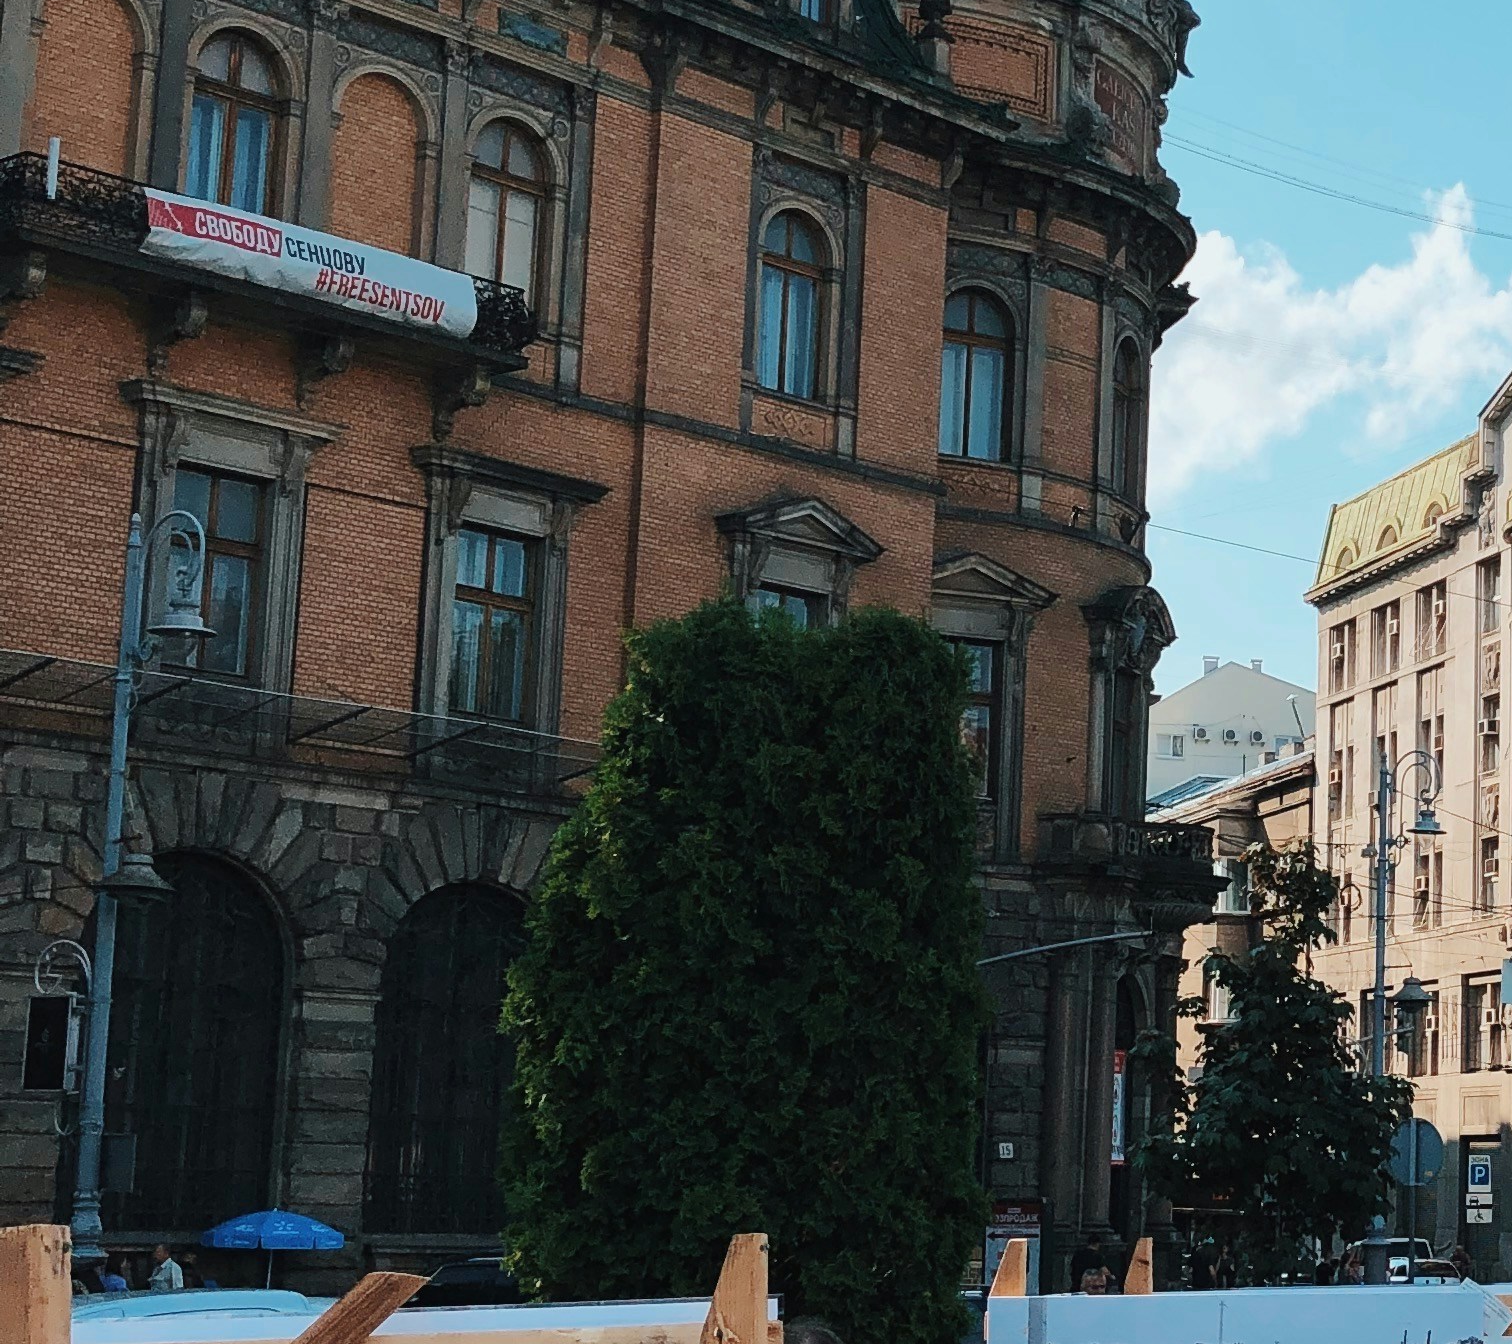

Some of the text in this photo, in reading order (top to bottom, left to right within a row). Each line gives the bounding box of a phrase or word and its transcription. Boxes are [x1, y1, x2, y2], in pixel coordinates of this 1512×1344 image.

[194, 211, 366, 276] СВОБОДУ СЕНЦОВУ
[314, 268, 446, 325] #FREESENTSOV
[1001, 1144, 1011, 1156] 15
